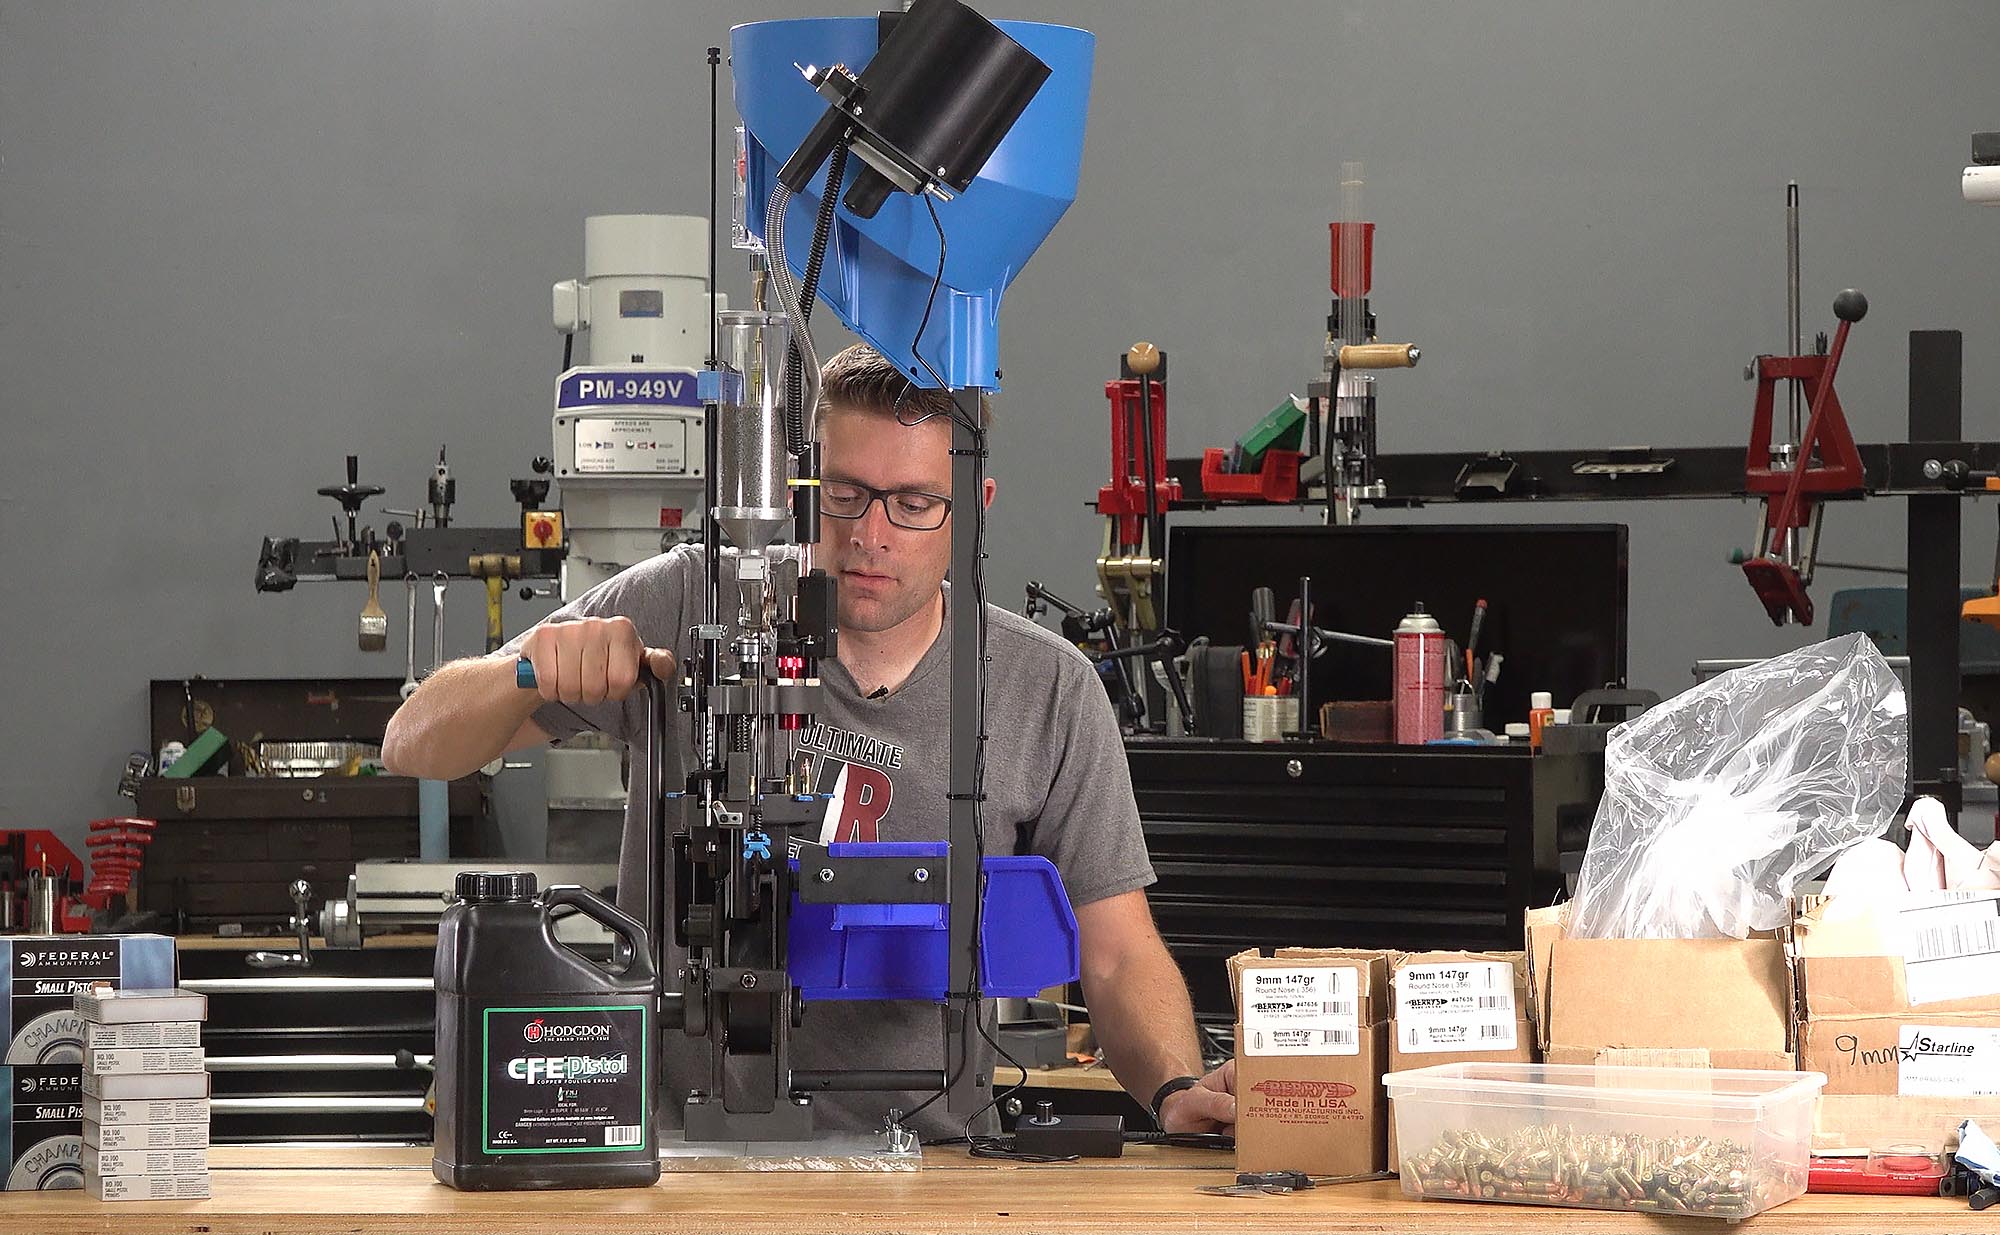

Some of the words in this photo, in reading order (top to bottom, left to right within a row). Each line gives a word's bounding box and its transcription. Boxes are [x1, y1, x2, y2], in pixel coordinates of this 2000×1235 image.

[579, 379, 683, 399] PM-949V
[800, 722, 904, 769] ULTIMATE
[38, 951, 111, 960] FEDERAL
[1255, 975, 1282, 985] 9mm
[1285, 975, 1315, 986] 147gr
[1408, 971, 1436, 981] 9mm
[1439, 970, 1469, 982] 147gr
[35, 980, 65, 994] SMALL
[544, 1025, 610, 1037] HODGDON
[1273, 1030, 1290, 1038] 9mm
[1292, 1030, 1311, 1038] 147gr
[1918, 1037, 1975, 1054] Starline
[507, 1056, 565, 1085] CFE
[567, 1054, 628, 1079] Pistol
[1265, 1098, 1299, 1107] Made
[1303, 1099, 1314, 1107] In
[1318, 1099, 1348, 1108] USA
[36, 1106, 65, 1119] SMALL
[25, 1143, 82, 1173] CHAMP
